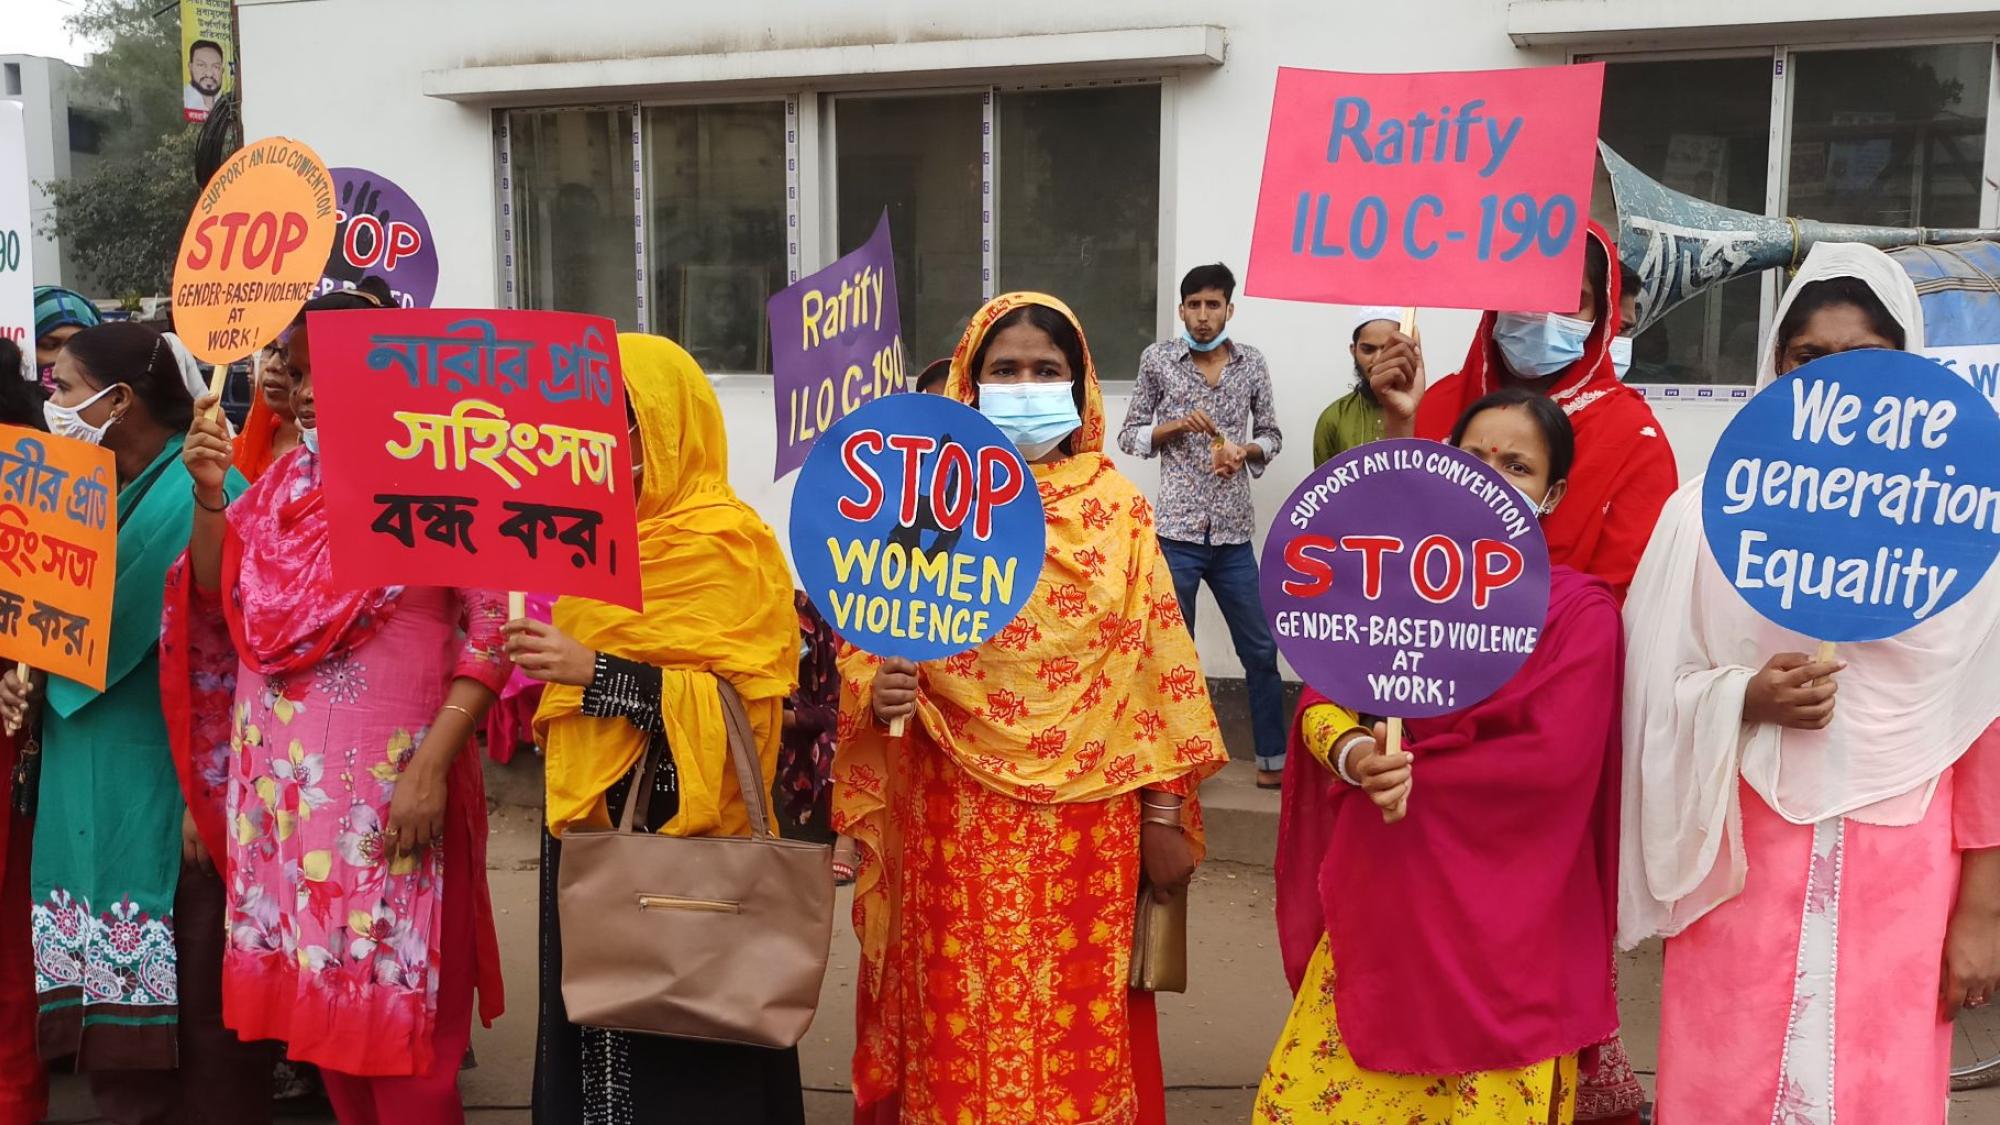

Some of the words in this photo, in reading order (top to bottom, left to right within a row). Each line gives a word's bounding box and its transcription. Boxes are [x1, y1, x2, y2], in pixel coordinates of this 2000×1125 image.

[1327, 96, 1523, 177] Ratify
[201, 155, 247, 214] SUPPORT
[249, 147, 264, 168] AN
[266, 145, 288, 164] ILO
[187, 211, 308, 275] STOP
[1291, 191, 1388, 261] ILO
[1403, 192, 1577, 262] C-190
[177, 281, 263, 307] GENDER-BASED
[264, 281, 315, 302] VIOLENCE
[228, 307, 245, 325] AT
[801, 264, 884, 351] Ratify
[366, 318, 536, 393] নারীর
[539, 326, 612, 406] প্রতি
[789, 377, 834, 447] ILO
[842, 334, 904, 416] C-190
[385, 399, 617, 494] সহিংসতা
[1792, 377, 1862, 446] We
[1867, 396, 1957, 451] are
[66, 464, 108, 530] প্রতি
[837, 428, 1025, 542] STOP
[1290, 459, 1361, 530] SUPPORT
[1363, 451, 1390, 476] AN
[1393, 449, 1424, 470] ILO
[1425, 452, 1531, 540] CONVENTION
[1722, 457, 2000, 534] generation
[371, 493, 479, 555] বন্ধ
[826, 536, 1018, 606] WOMEN
[1281, 533, 1524, 610] STOP
[1735, 530, 1958, 620] Equality
[828, 588, 991, 645] VIOLENCE
[1275, 611, 1445, 649] GENDER-BASED
[1448, 622, 1538, 653] VIOLENCE
[1392, 650, 1424, 673] AT
